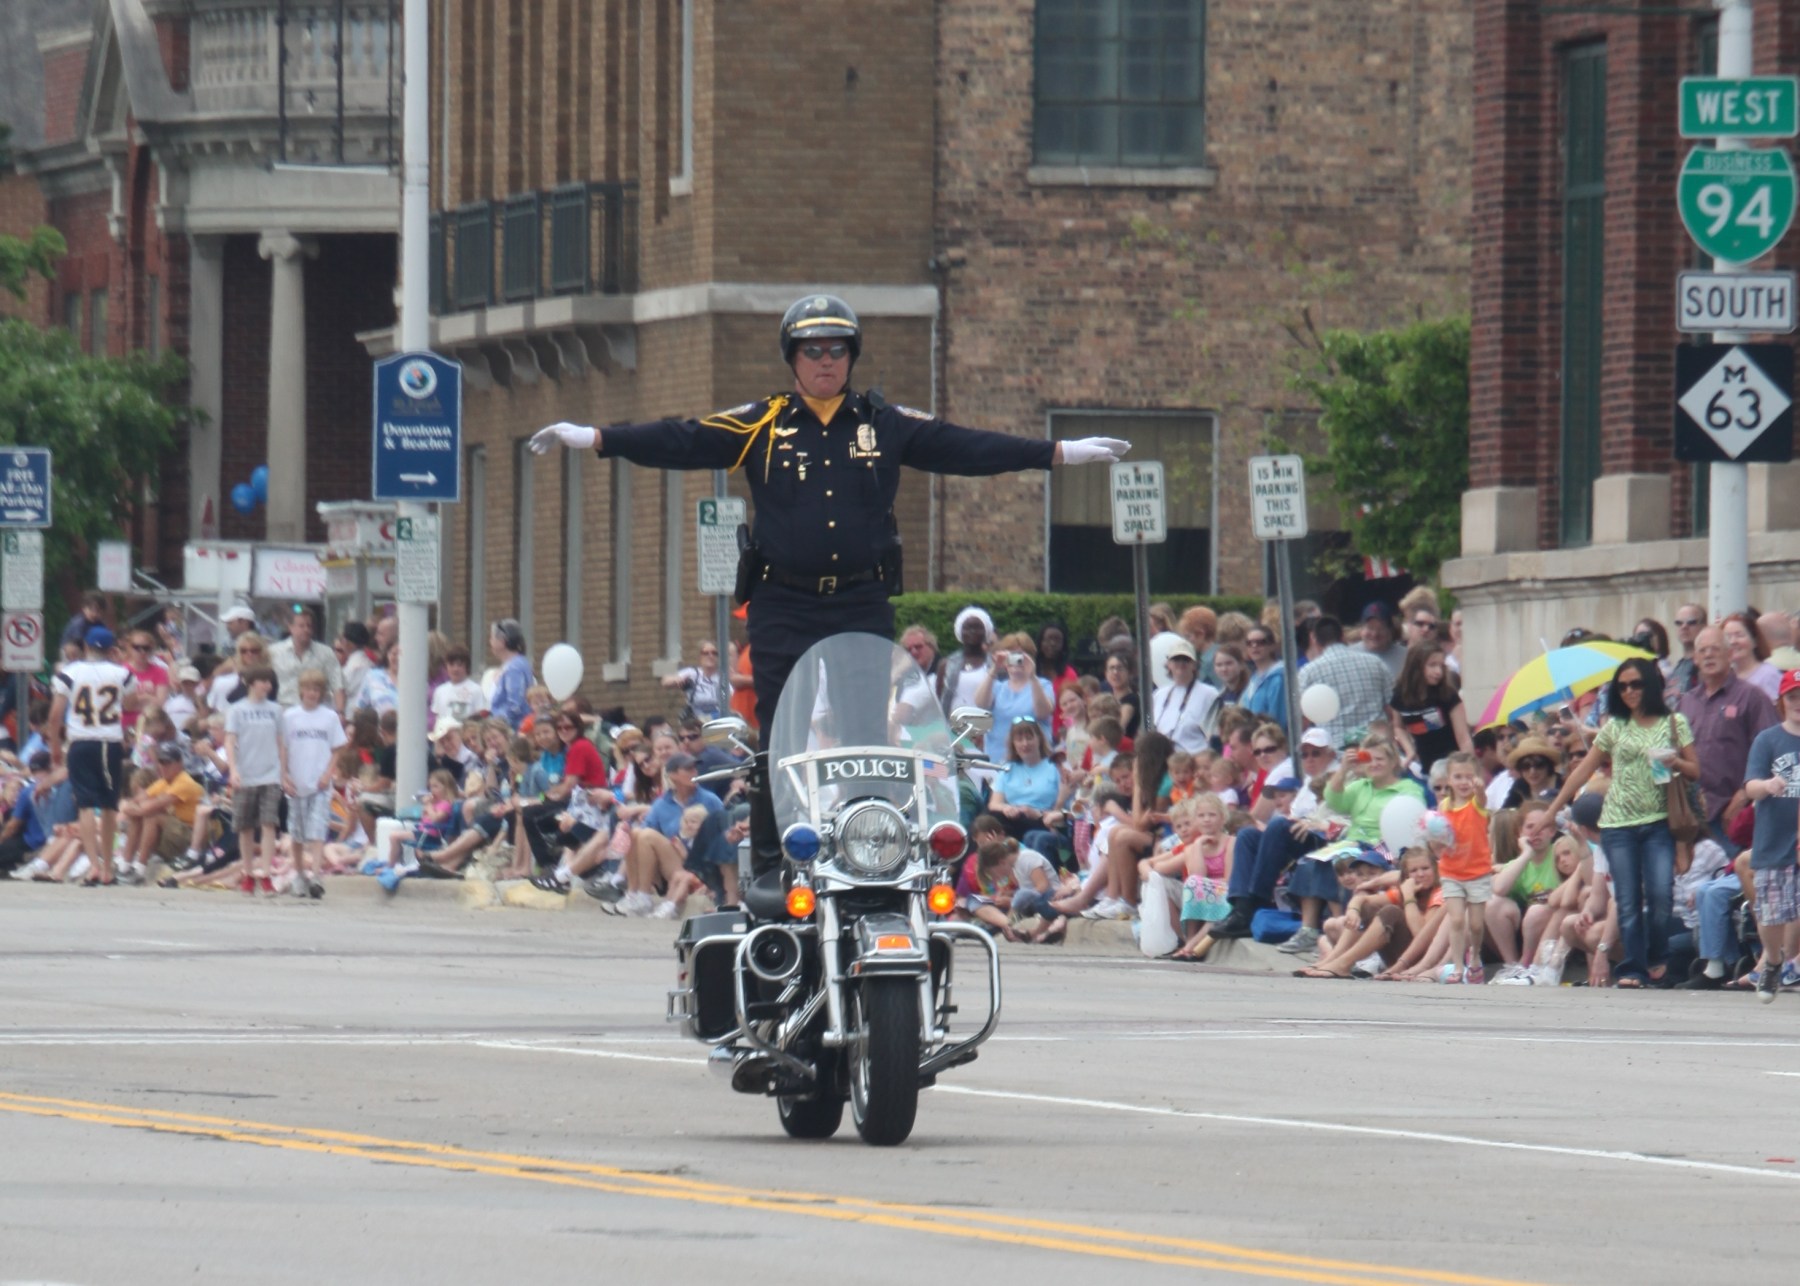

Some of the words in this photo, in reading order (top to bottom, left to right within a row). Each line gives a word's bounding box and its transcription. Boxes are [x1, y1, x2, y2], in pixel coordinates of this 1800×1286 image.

[1696, 89, 1781, 125] WEST
[1703, 154, 1772, 172] BUSINESS
[1696, 183, 1776, 239] 94
[1685, 286, 1785, 319] SOUTH
[1722, 366, 1747, 384] M
[1704, 388, 1762, 431] 63
[382, 421, 453, 438] Downtown
[401, 436, 451, 451] Beaches
[1134, 472, 1155, 485] MIN
[1272, 466, 1293, 479] MIN
[1116, 488, 1159, 501] PARKING
[1255, 482, 1299, 497] PARKING
[703, 503, 715, 524] 2
[1127, 503, 1152, 517] THIS
[1266, 499, 1291, 512] THIS
[1123, 519, 1156, 534] SPACE
[1262, 514, 1296, 528] SPACE
[74, 685, 119, 726] 42
[824, 759, 909, 781] POLICE
